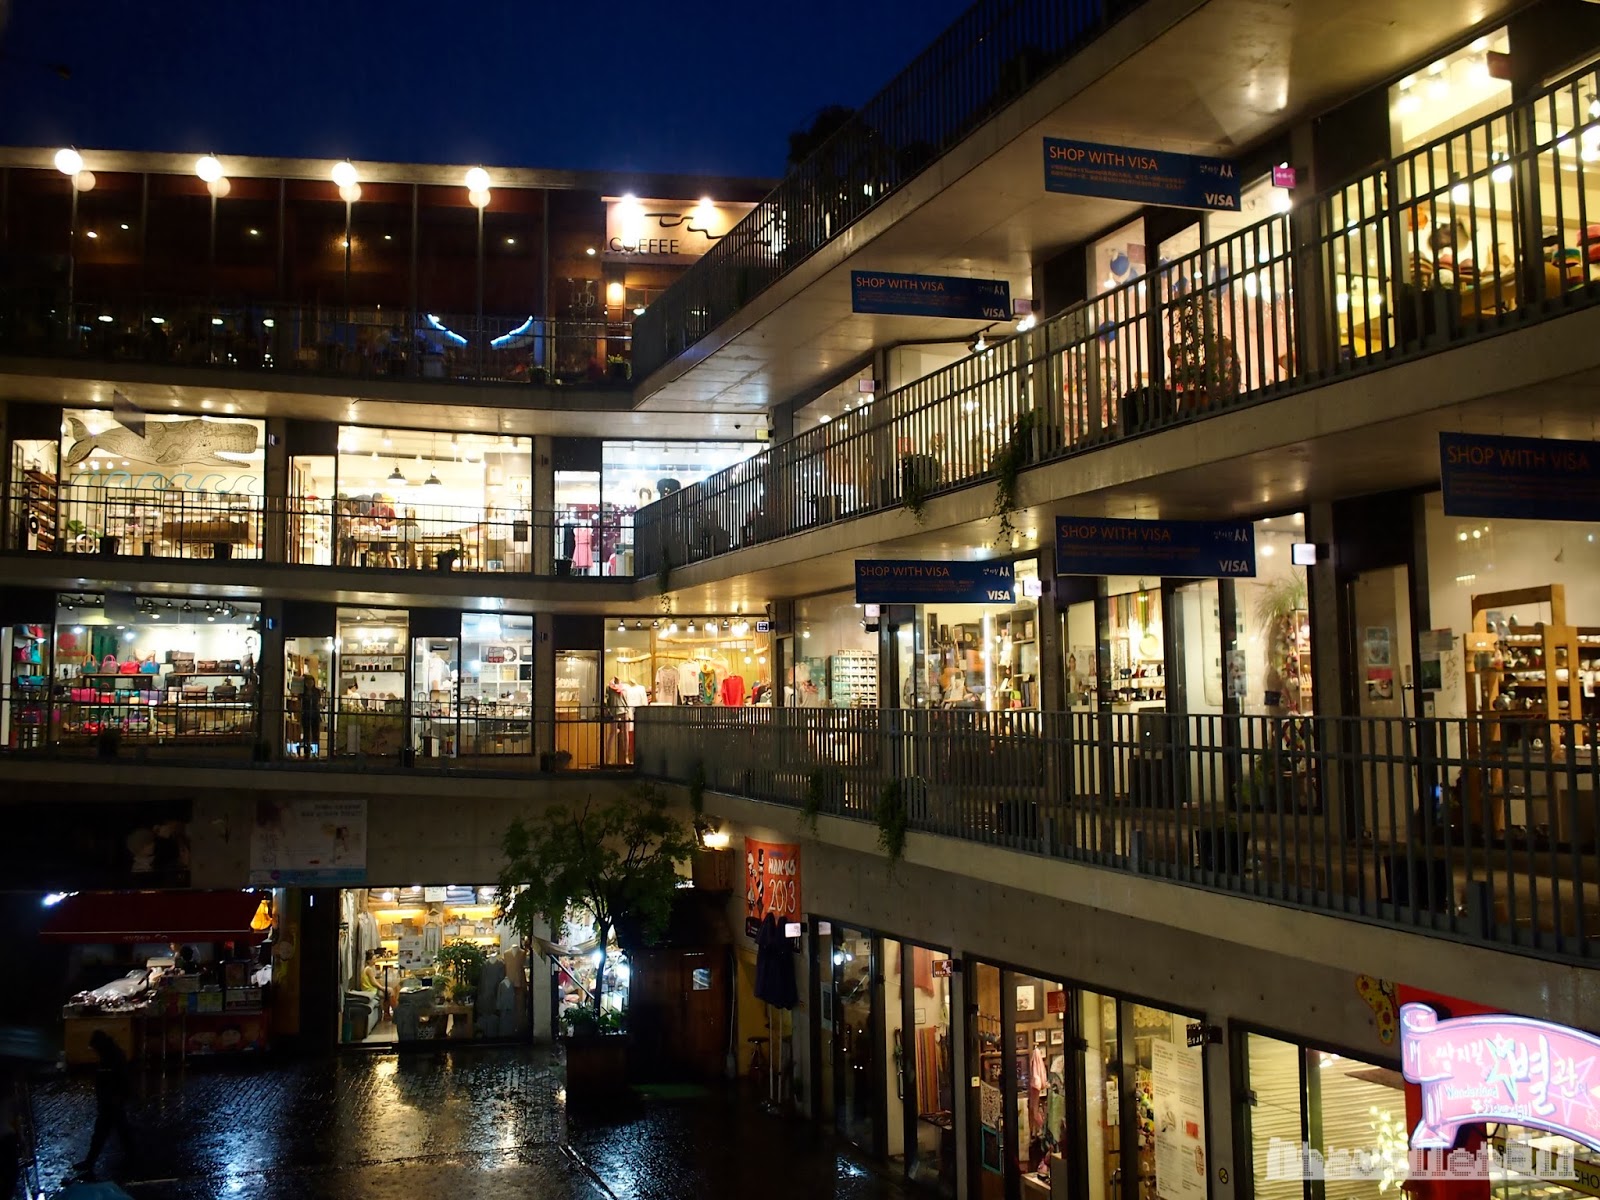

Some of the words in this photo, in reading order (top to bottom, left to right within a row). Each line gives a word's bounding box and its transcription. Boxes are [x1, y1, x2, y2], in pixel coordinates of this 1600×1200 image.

[1049, 146, 1085, 162] SHOP
[1089, 151, 1125, 167] WITH
[1128, 156, 1158, 170] VISA
[1205, 192, 1234, 207] VISA
[856, 276, 886, 288] SHOP
[888, 279, 918, 290] WITH
[920, 281, 945, 291] VISA
[983, 307, 1006, 318] VISA
[1447, 445, 1495, 465] SHOP
[1499, 448, 1546, 469] WITH
[1551, 451, 1590, 471] VISA
[1061, 525, 1097, 539] SHOP
[1101, 526, 1137, 540] WITH
[1141, 527, 1171, 541] VISA
[860, 566, 890, 577] SHOP
[892, 566, 922, 577] WITH
[925, 566, 950, 576] VISA
[1218, 559, 1249, 572] VISA
[986, 590, 1011, 600] VISA
[768, 879, 796, 913] 2013
